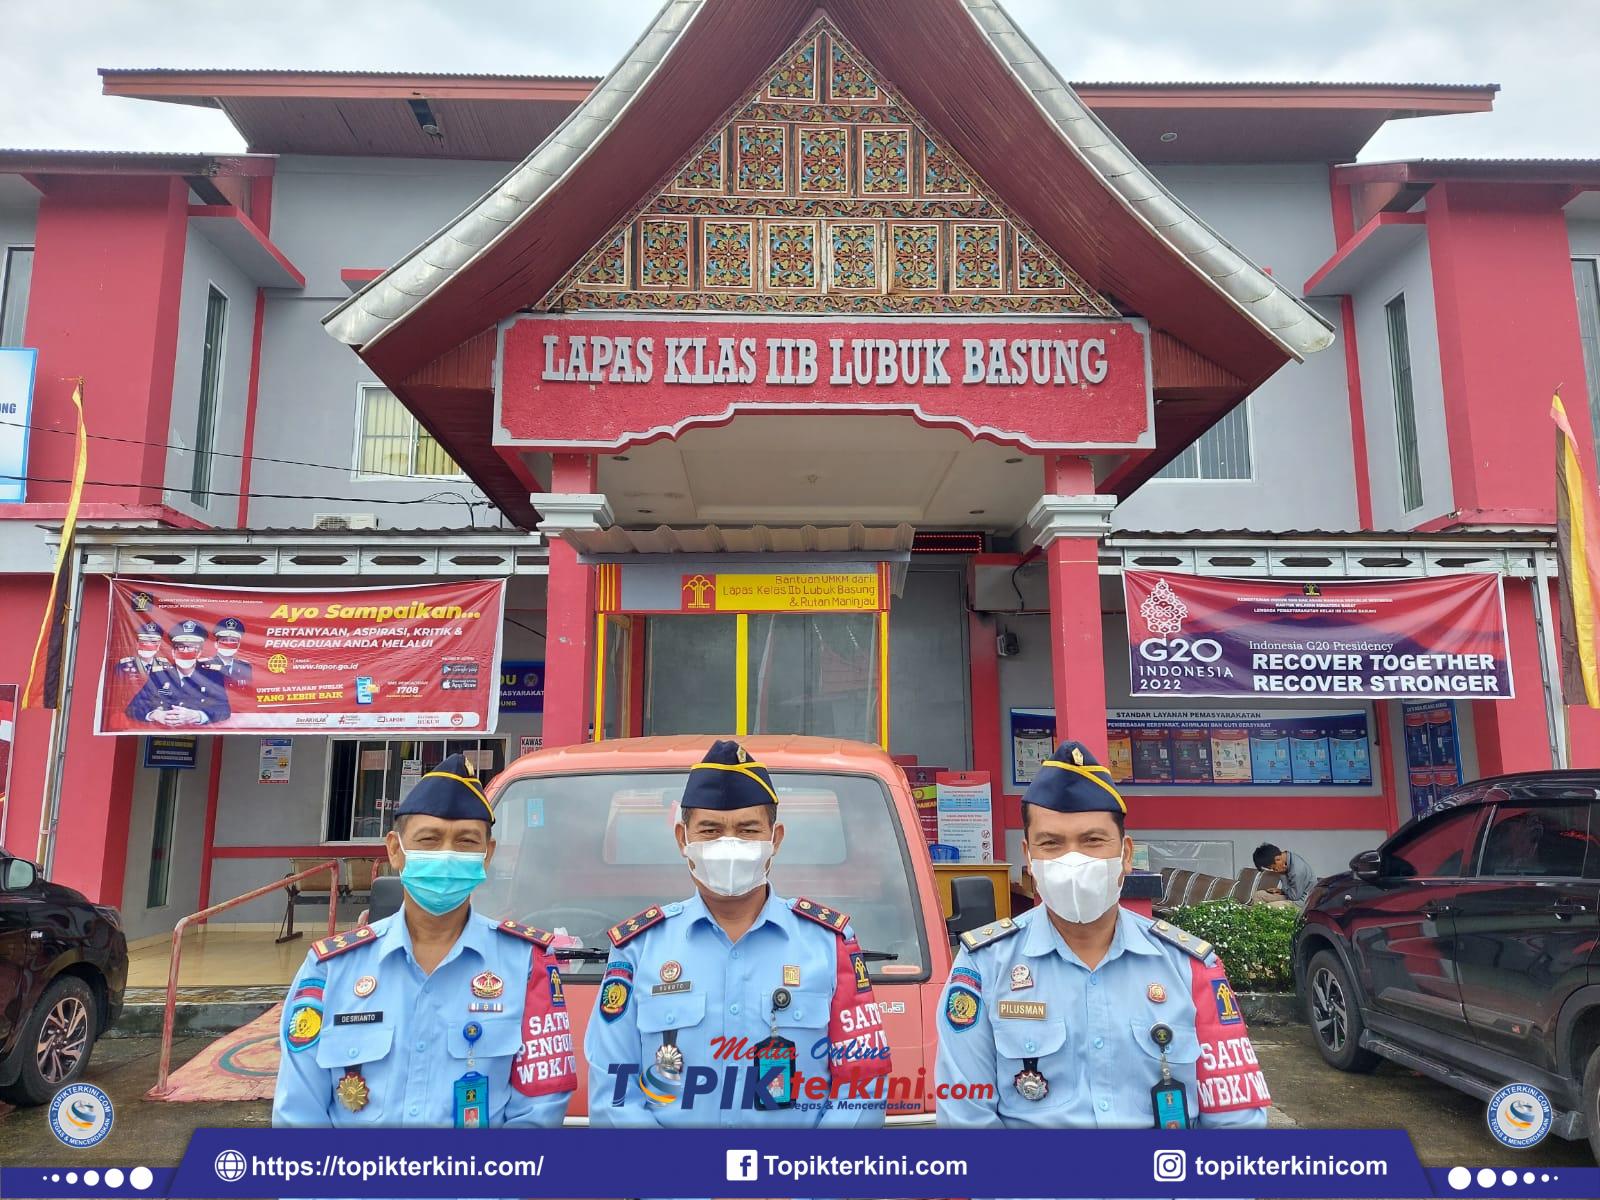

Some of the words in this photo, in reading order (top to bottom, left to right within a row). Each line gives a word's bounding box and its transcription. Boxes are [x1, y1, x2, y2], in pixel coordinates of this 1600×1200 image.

[541, 335, 653, 382] LAPAS
[664, 337, 757, 383] KLAS
[766, 338, 818, 384] IIB
[829, 338, 951, 385] LUBUK
[962, 338, 1108, 385] BASUNG
[775, 576, 820, 585] Bantuan
[821, 575, 849, 583] UMKM
[723, 586, 753, 597] Lapas
[757, 586, 786, 595] Kelas
[803, 586, 834, 595] Lubuk
[837, 586, 875, 598] Basung
[789, 598, 800, 607] &
[801, 598, 831, 607] Rutan
[832, 598, 875, 609] Maninjau
[270, 604, 319, 622] Ayo
[324, 601, 480, 622] Sampaikan...
[266, 627, 350, 637] PERTANYAAN,
[352, 627, 411, 637] ASPIRASI,
[413, 627, 452, 636] KRITIK
[455, 627, 463, 636] &
[265, 639, 340, 648] PENGADUAN
[343, 639, 379, 648] ANDA
[381, 639, 433, 648] MELALUI
[1139, 637, 1223, 662] G20
[1249, 640, 1303, 650] Indonesia
[1306, 641, 1329, 650] G20
[1333, 641, 1393, 653] Presidency
[1252, 653, 1362, 670] RECOVER
[1370, 653, 1496, 671] TOGETHER
[1139, 665, 1233, 678] INDONESIA
[282, 684, 316, 692] LAYANAN
[319, 683, 344, 691] PUBLIK
[1140, 679, 1181, 690] 2022
[1253, 675, 1364, 692] RECOVER
[1370, 675, 1499, 692] STRONGER
[396, 686, 419, 694] 1708
[256, 694, 285, 702] YANG
[286, 692, 316, 701] LEBIH
[319, 691, 343, 699] BAIK
[1116, 711, 1151, 719] STANDAR
[1153, 711, 1188, 719] LAYANAN
[1190, 711, 1261, 719] PEMASYARAKATAN
[879, 1001, 905, 1014] 1.5
[1000, 1003, 1044, 1016] PILUSMAN
[341, 1014, 376, 1023] DESRIANTO
[1200, 1037, 1258, 1071] SATG
